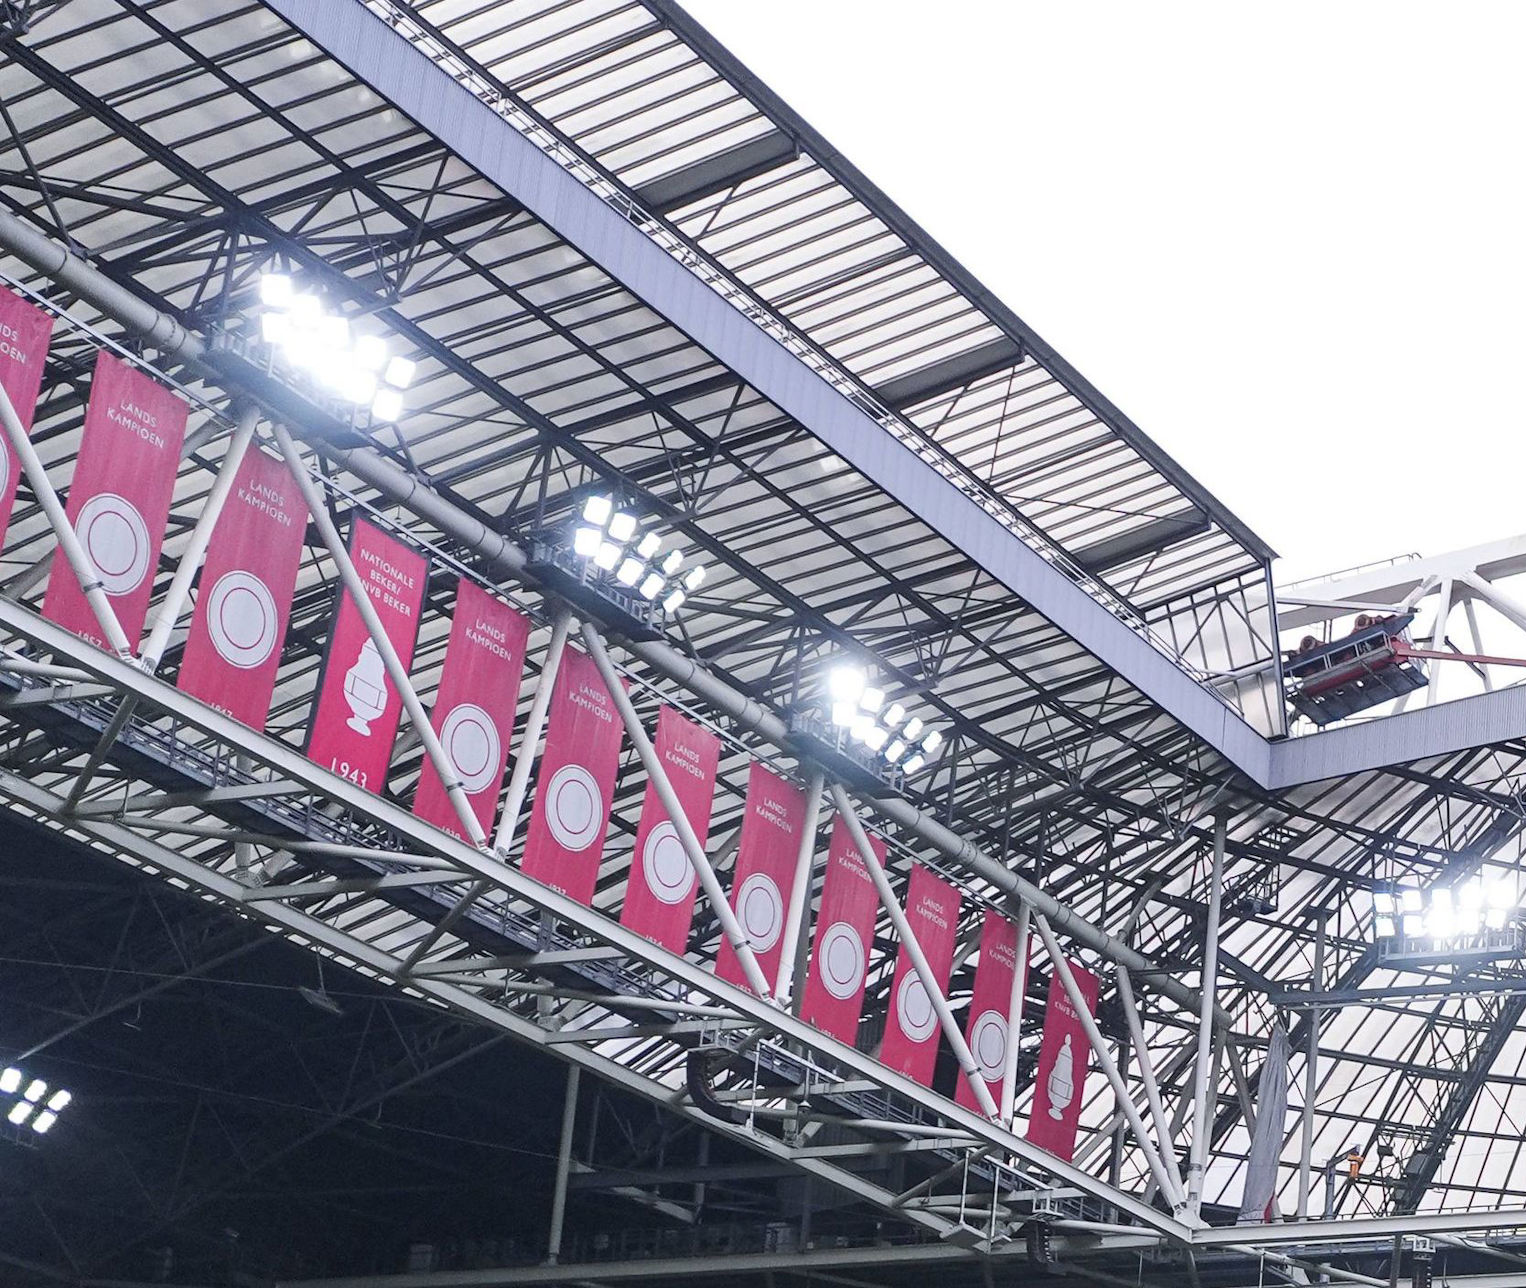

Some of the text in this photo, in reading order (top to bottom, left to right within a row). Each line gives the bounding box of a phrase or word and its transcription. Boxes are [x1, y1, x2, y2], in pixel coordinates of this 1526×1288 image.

[106, 408, 164, 449] KAMPIOEN
[121, 400, 157, 428] LANDS
[237, 488, 291, 527] KAMPIOEN
[250, 479, 285, 508] LANDS
[360, 549, 415, 589] NATIONALE
[361, 579, 411, 617] NVB BEKER
[466, 627, 512, 661] KAMPIOEN
[476, 619, 505, 644] LANDS
[569, 691, 612, 723] KAMPIOEN
[579, 684, 607, 706] LANDS
[665, 751, 705, 780] KAMPIOEN
[674, 742, 700, 764] LANDS
[331, 757, 367, 789] 1943
[756, 805, 792, 833] KAMPIOEN
[763, 797, 787, 818] LANDS
